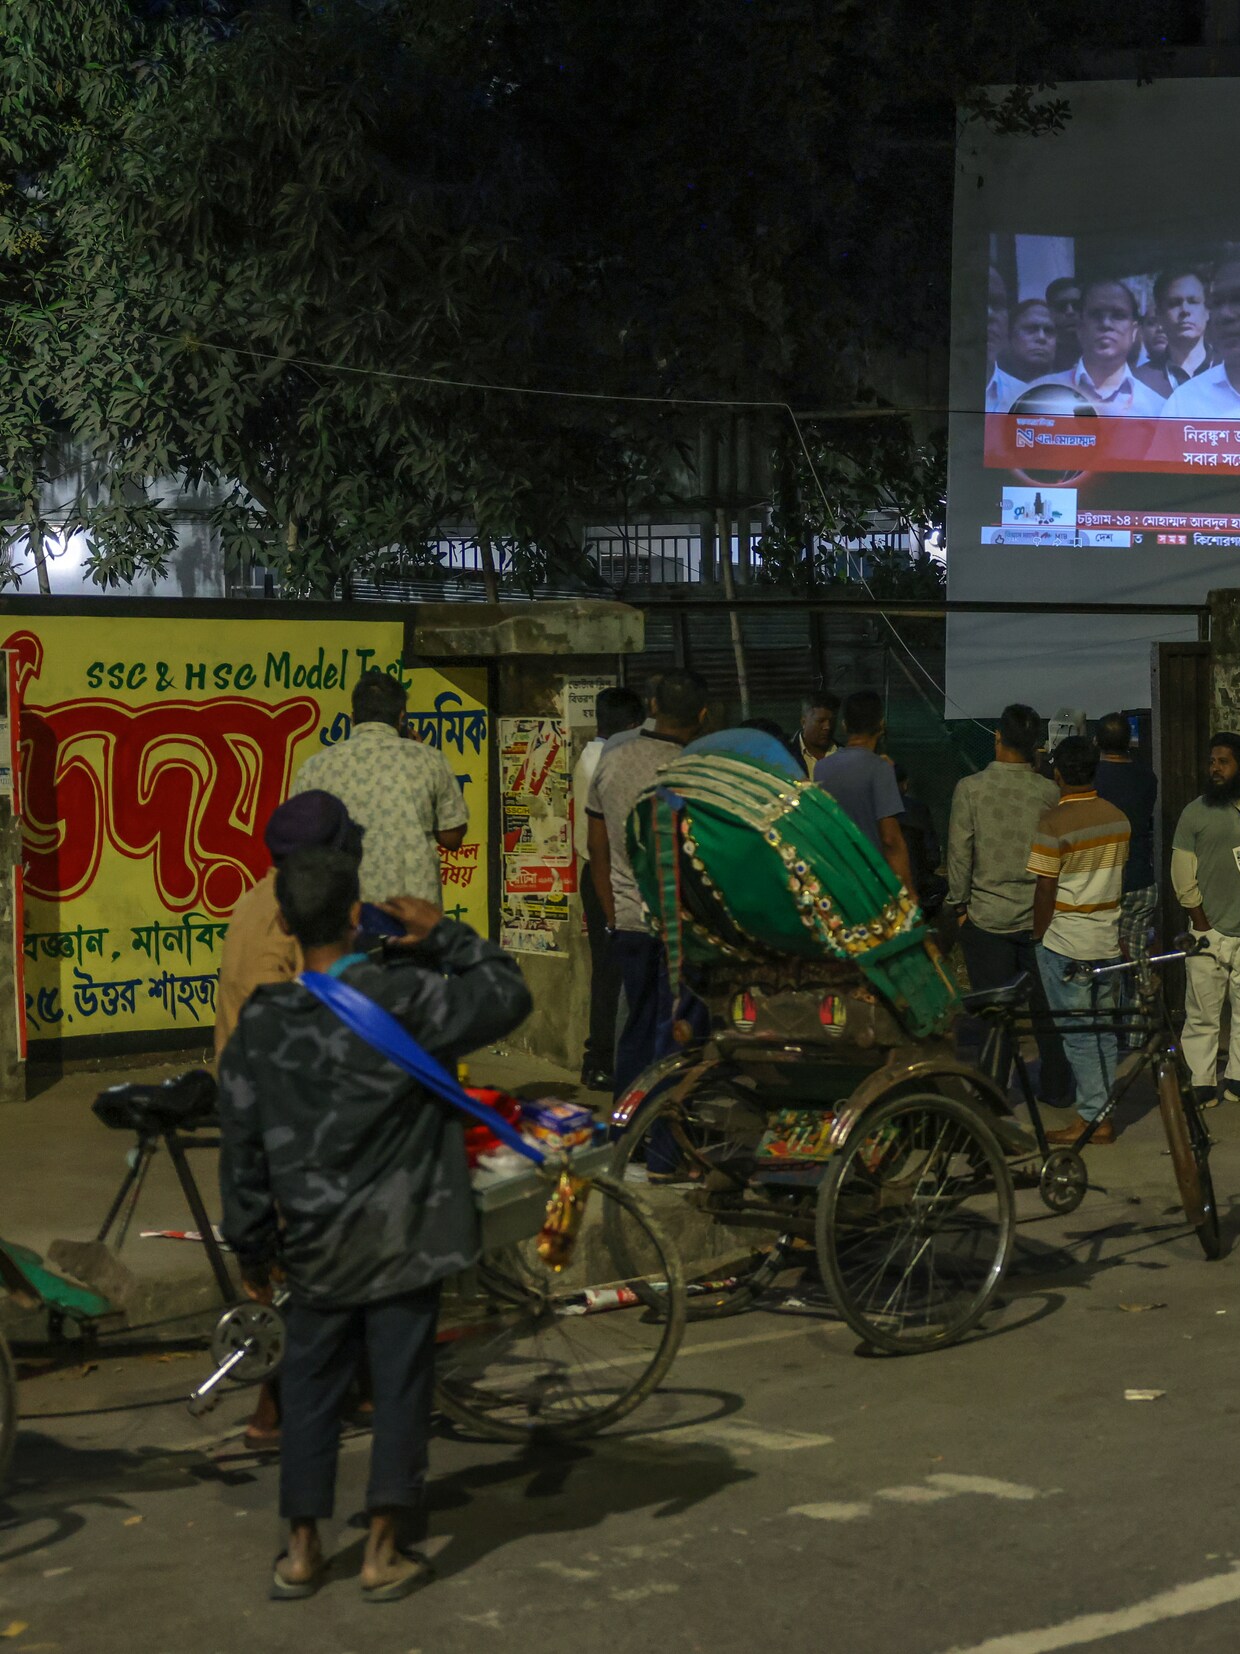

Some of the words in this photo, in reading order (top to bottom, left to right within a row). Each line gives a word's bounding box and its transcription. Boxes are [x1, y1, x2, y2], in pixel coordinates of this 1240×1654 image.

[1184, 425, 1229, 447] নিরঙ্কুশ
[1183, 451, 1218, 467] সবার
[1077, 513, 1131, 527] চট্টগ্রাম-১৪
[1142, 514, 1187, 528] মোহাম্মদ
[1190, 516, 1227, 531] আবদুল
[86, 661, 147, 690] SSC
[156, 661, 177, 691] &
[185, 661, 257, 691] HSC
[264, 647, 349, 691] Model
[73, 966, 143, 1017] উত্তর
